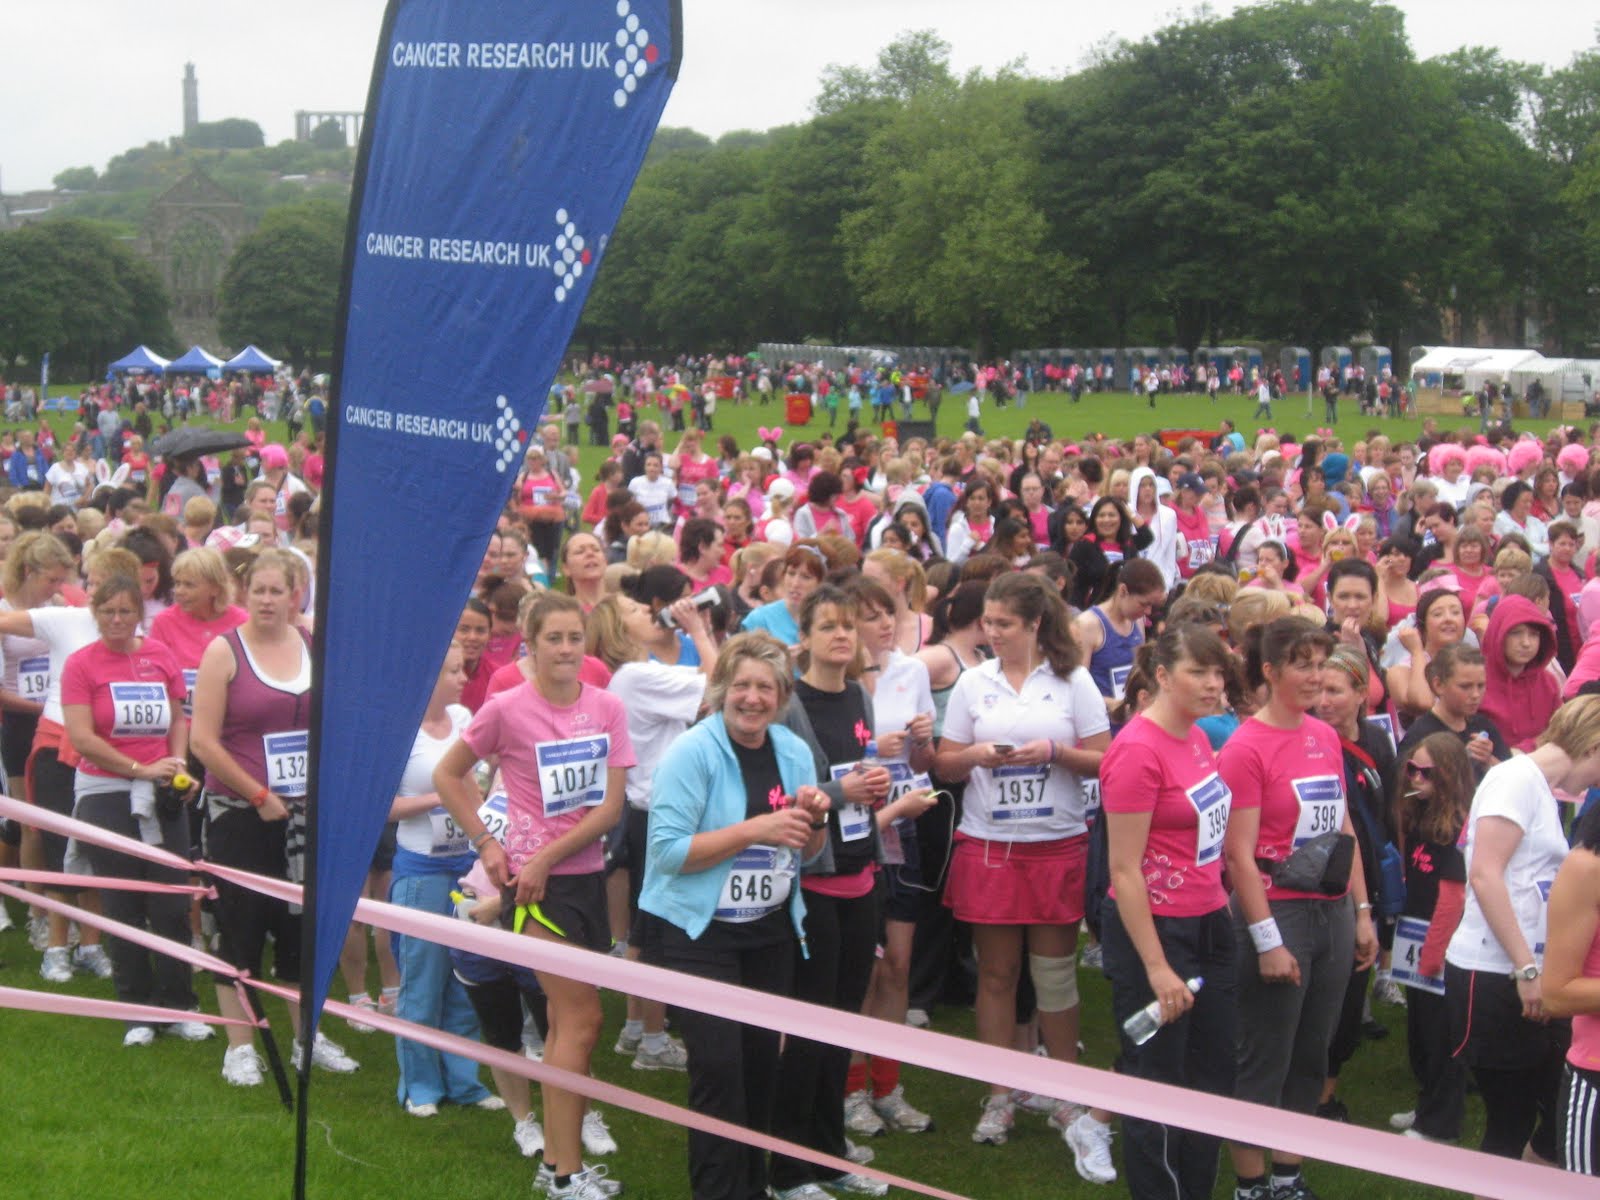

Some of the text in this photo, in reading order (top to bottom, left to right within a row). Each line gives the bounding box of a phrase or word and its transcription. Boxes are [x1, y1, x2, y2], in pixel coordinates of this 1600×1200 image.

[393, 42, 610, 69] CANCER RESEARCH UK
[366, 232, 551, 268] CANCER RESEARCH UK
[346, 404, 493, 444] CANCER RESEARCH UK
[123, 703, 163, 726] 1687
[550, 762, 598, 796] 1011
[998, 778, 1046, 805] 1937
[1208, 804, 1227, 839] 399
[1311, 805, 1337, 832] 398
[730, 874, 773, 902] 646
